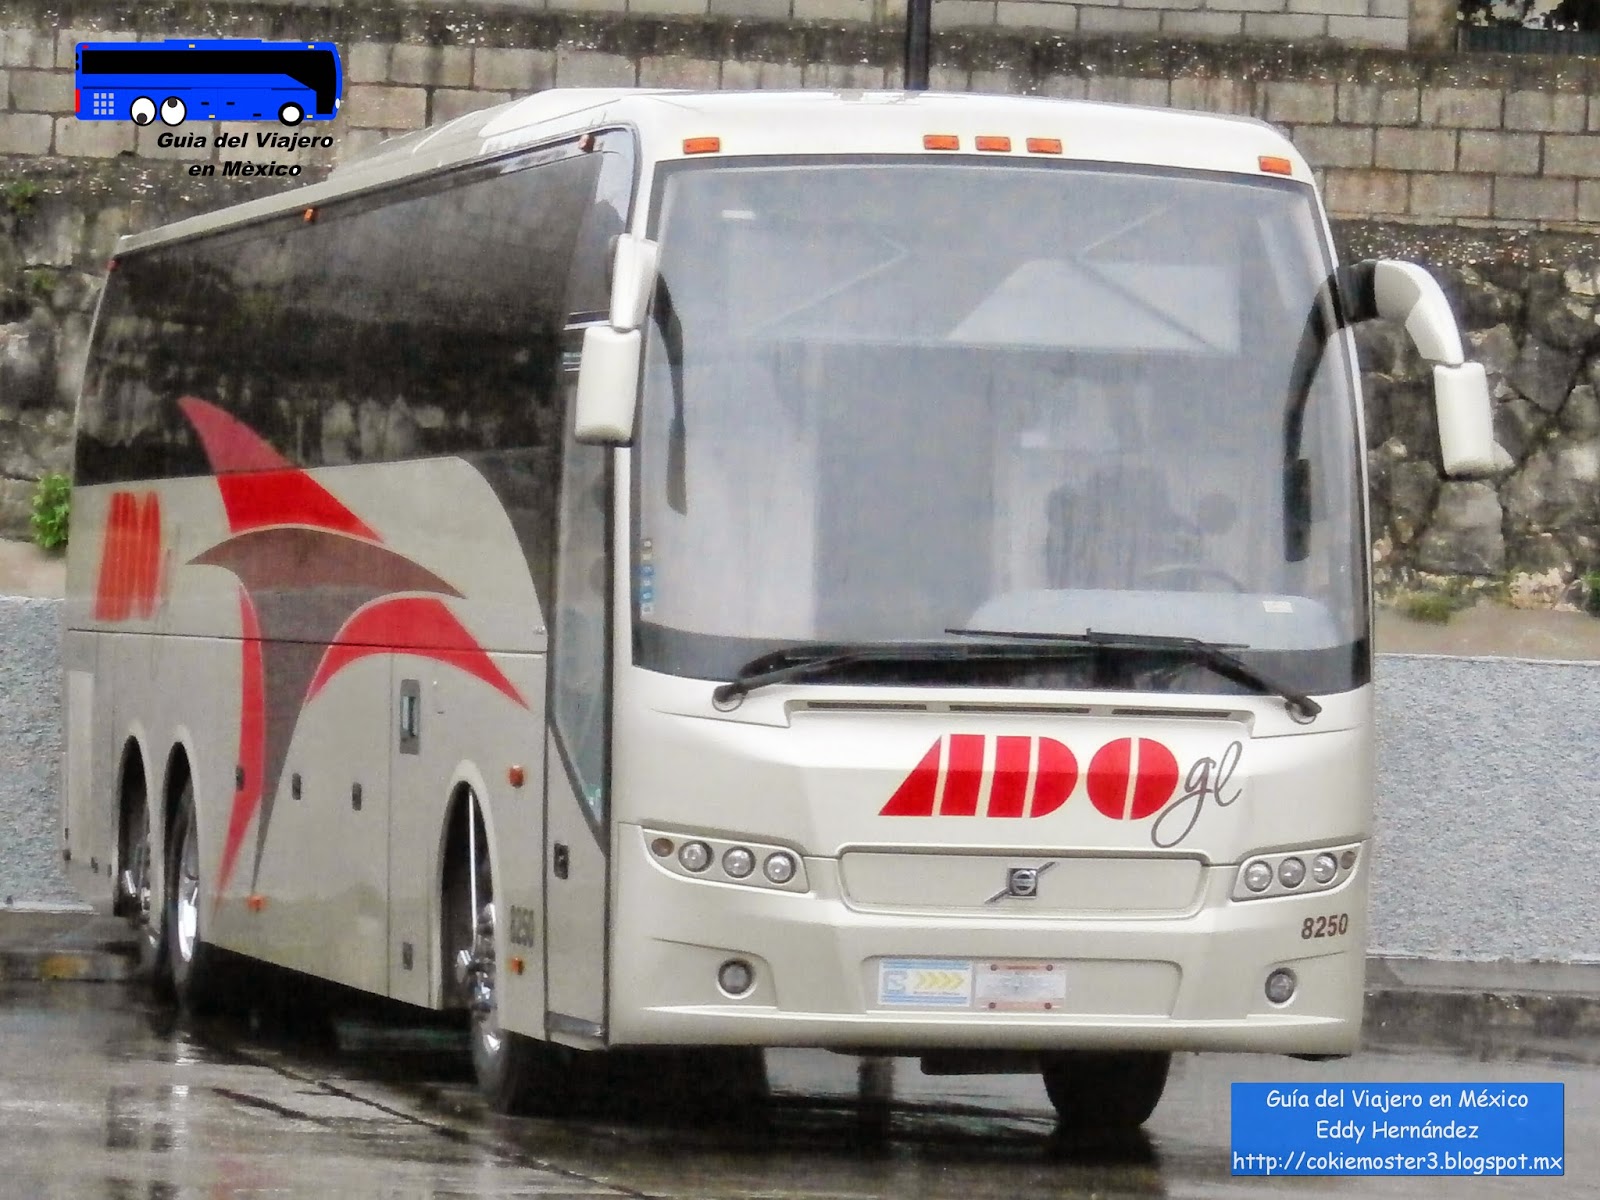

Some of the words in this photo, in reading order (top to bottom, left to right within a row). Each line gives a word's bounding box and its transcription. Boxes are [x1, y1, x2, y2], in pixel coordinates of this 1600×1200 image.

[878, 733, 1179, 820] ADO
[1151, 740, 1243, 848] gl
[1301, 913, 1349, 940] 8250
